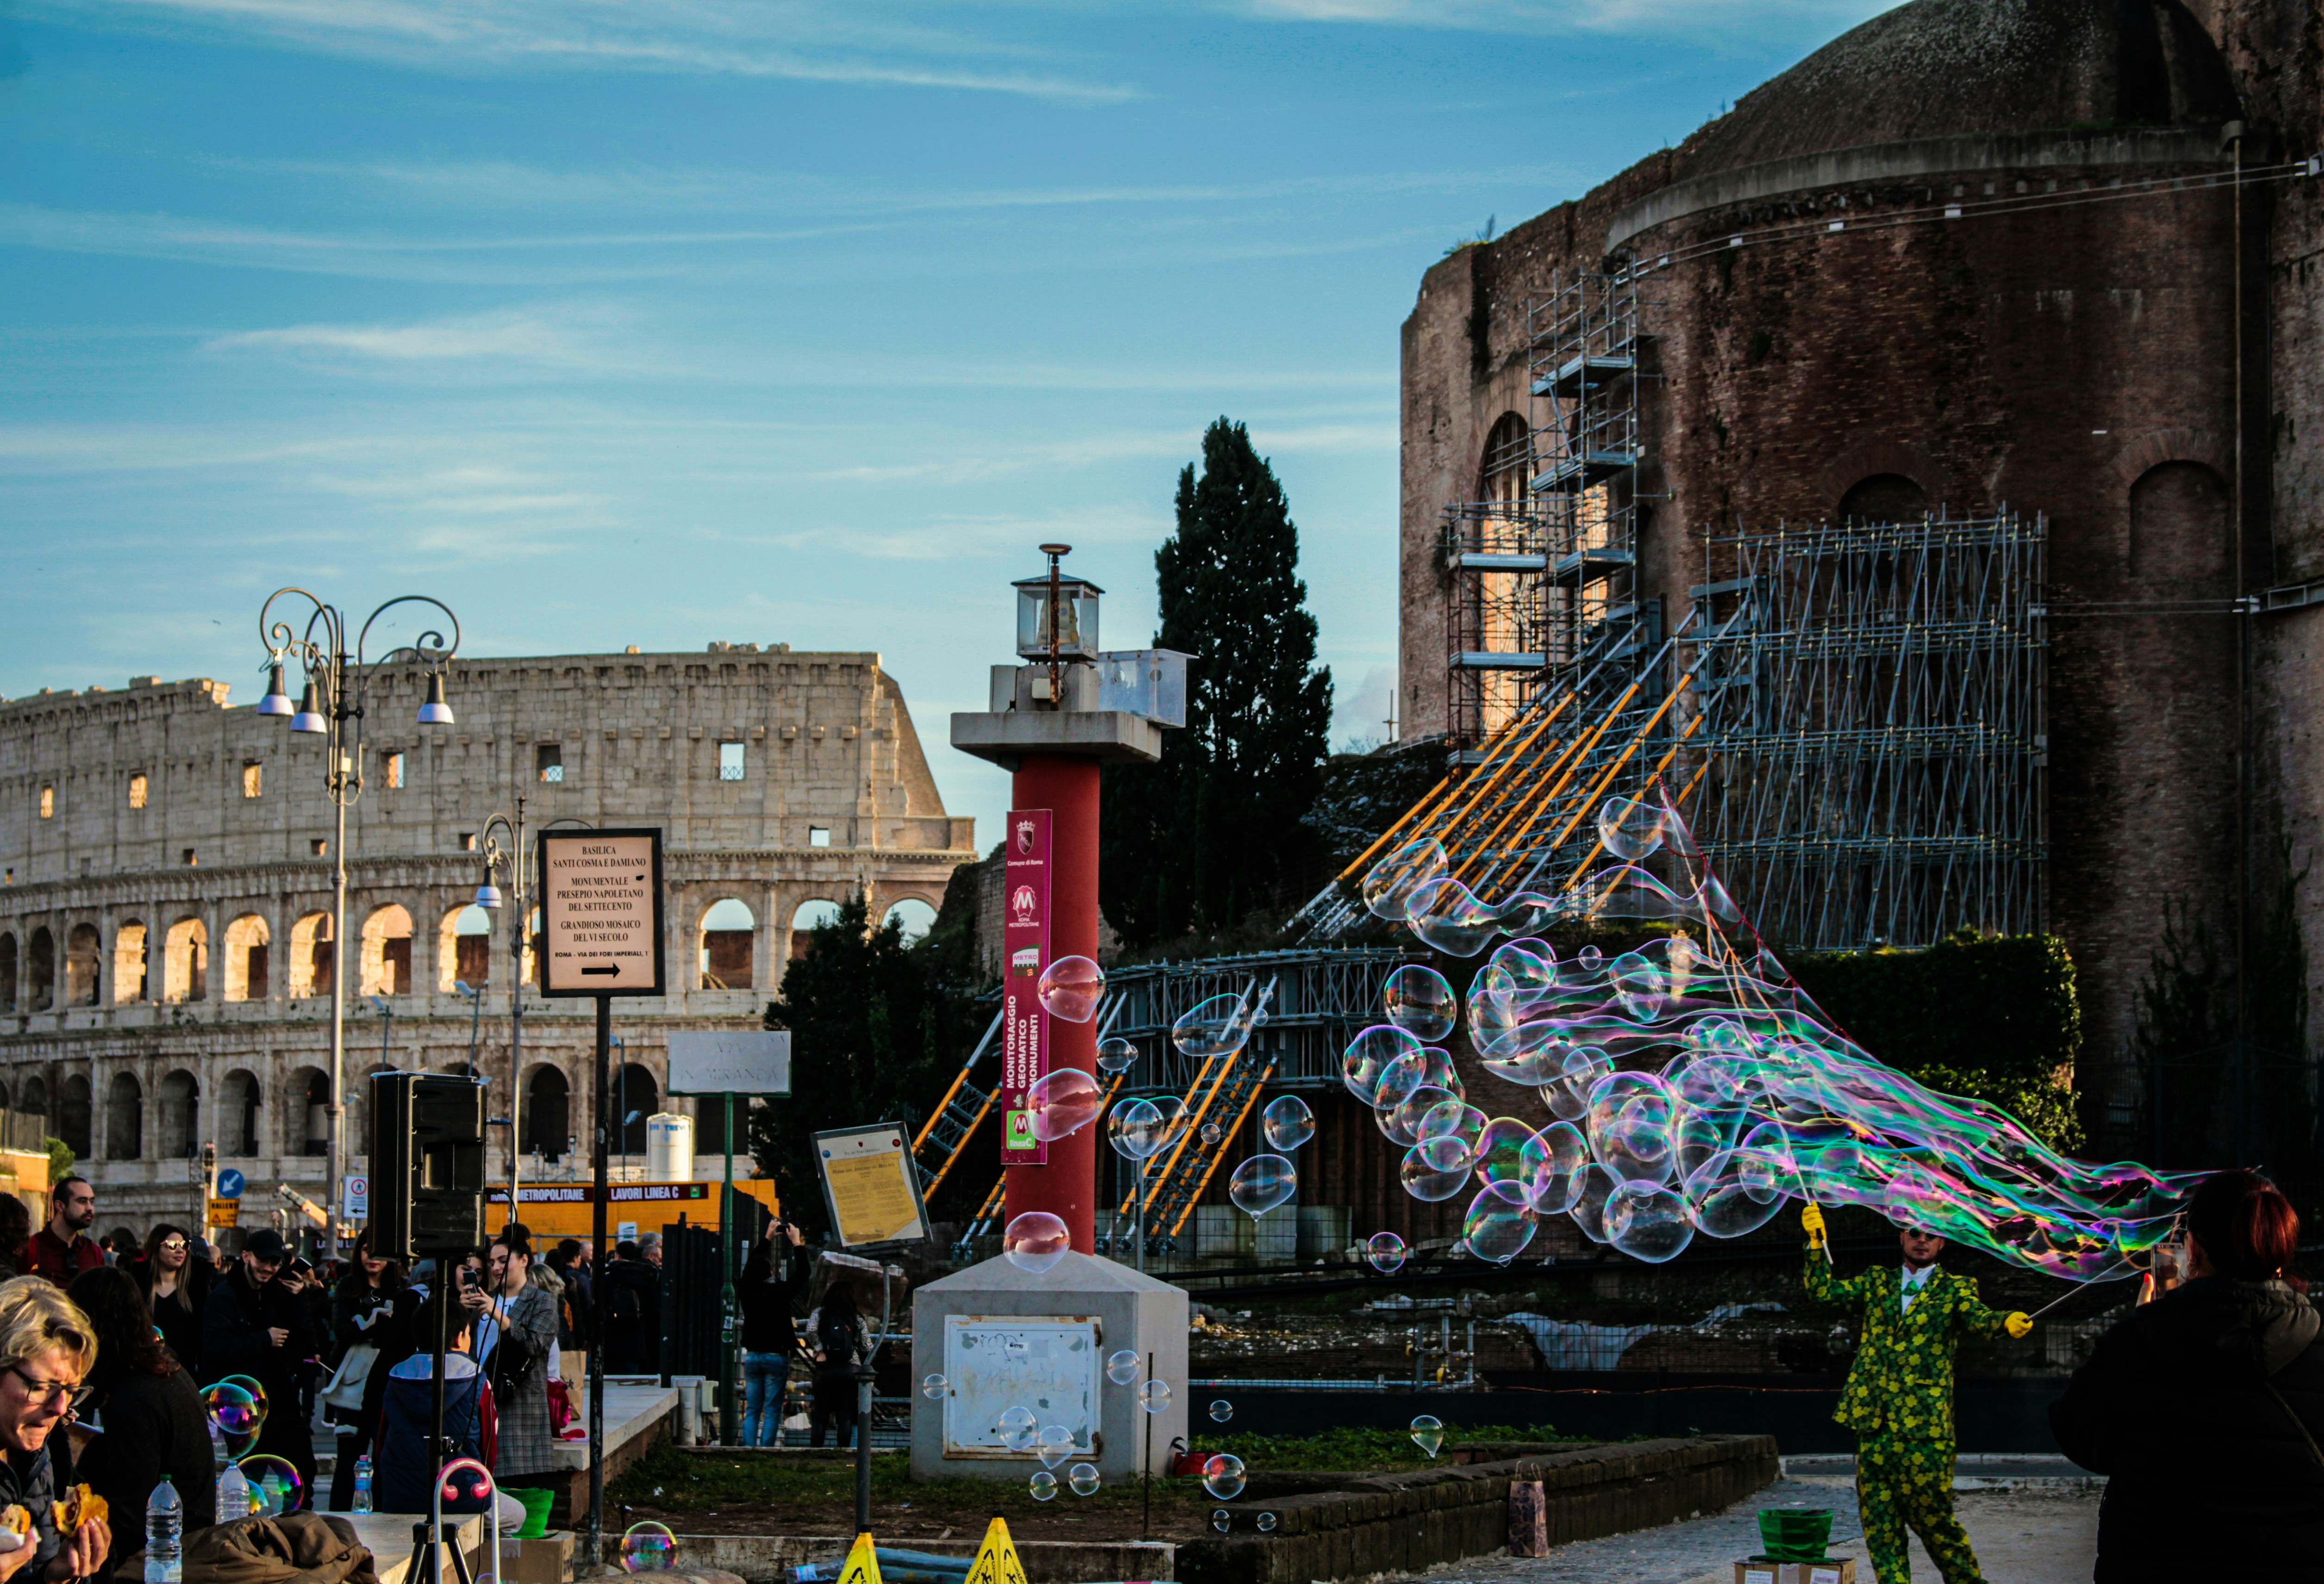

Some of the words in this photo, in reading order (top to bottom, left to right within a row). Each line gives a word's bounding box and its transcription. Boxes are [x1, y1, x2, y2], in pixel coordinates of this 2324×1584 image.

[582, 846, 616, 855] BASILICA
[553, 859, 574, 868] SANTI
[576, 859, 602, 867] COSMA
[604, 859, 609, 867] E
[611, 858, 646, 867] DAMIANO
[571, 877, 629, 886] MONUMENTALE
[557, 890, 592, 899] PRESEPIO
[594, 889, 643, 898] NAPOLETANO
[1016, 892, 1034, 909] M
[569, 903, 583, 911] DEL
[584, 902, 632, 911] SETTECENTO
[561, 921, 604, 930] GRANDIOSO
[606, 920, 641, 929] MOSAICO
[573, 933, 588, 942] DEL
[598, 933, 628, 941] SECOLO
[1007, 996, 1016, 1089] MONITORAGGIO
[1018, 1019, 1027, 1089] GEOMATICO
[1029, 1014, 1038, 1088] MONUMENTI
[1015, 1117, 1028, 1129] M
[517, 1189, 584, 1201] METROPOLITANE
[611, 1188, 642, 1200] LAVORI
[645, 1186, 671, 1199] LINEA
[672, 1186, 679, 1198] C
